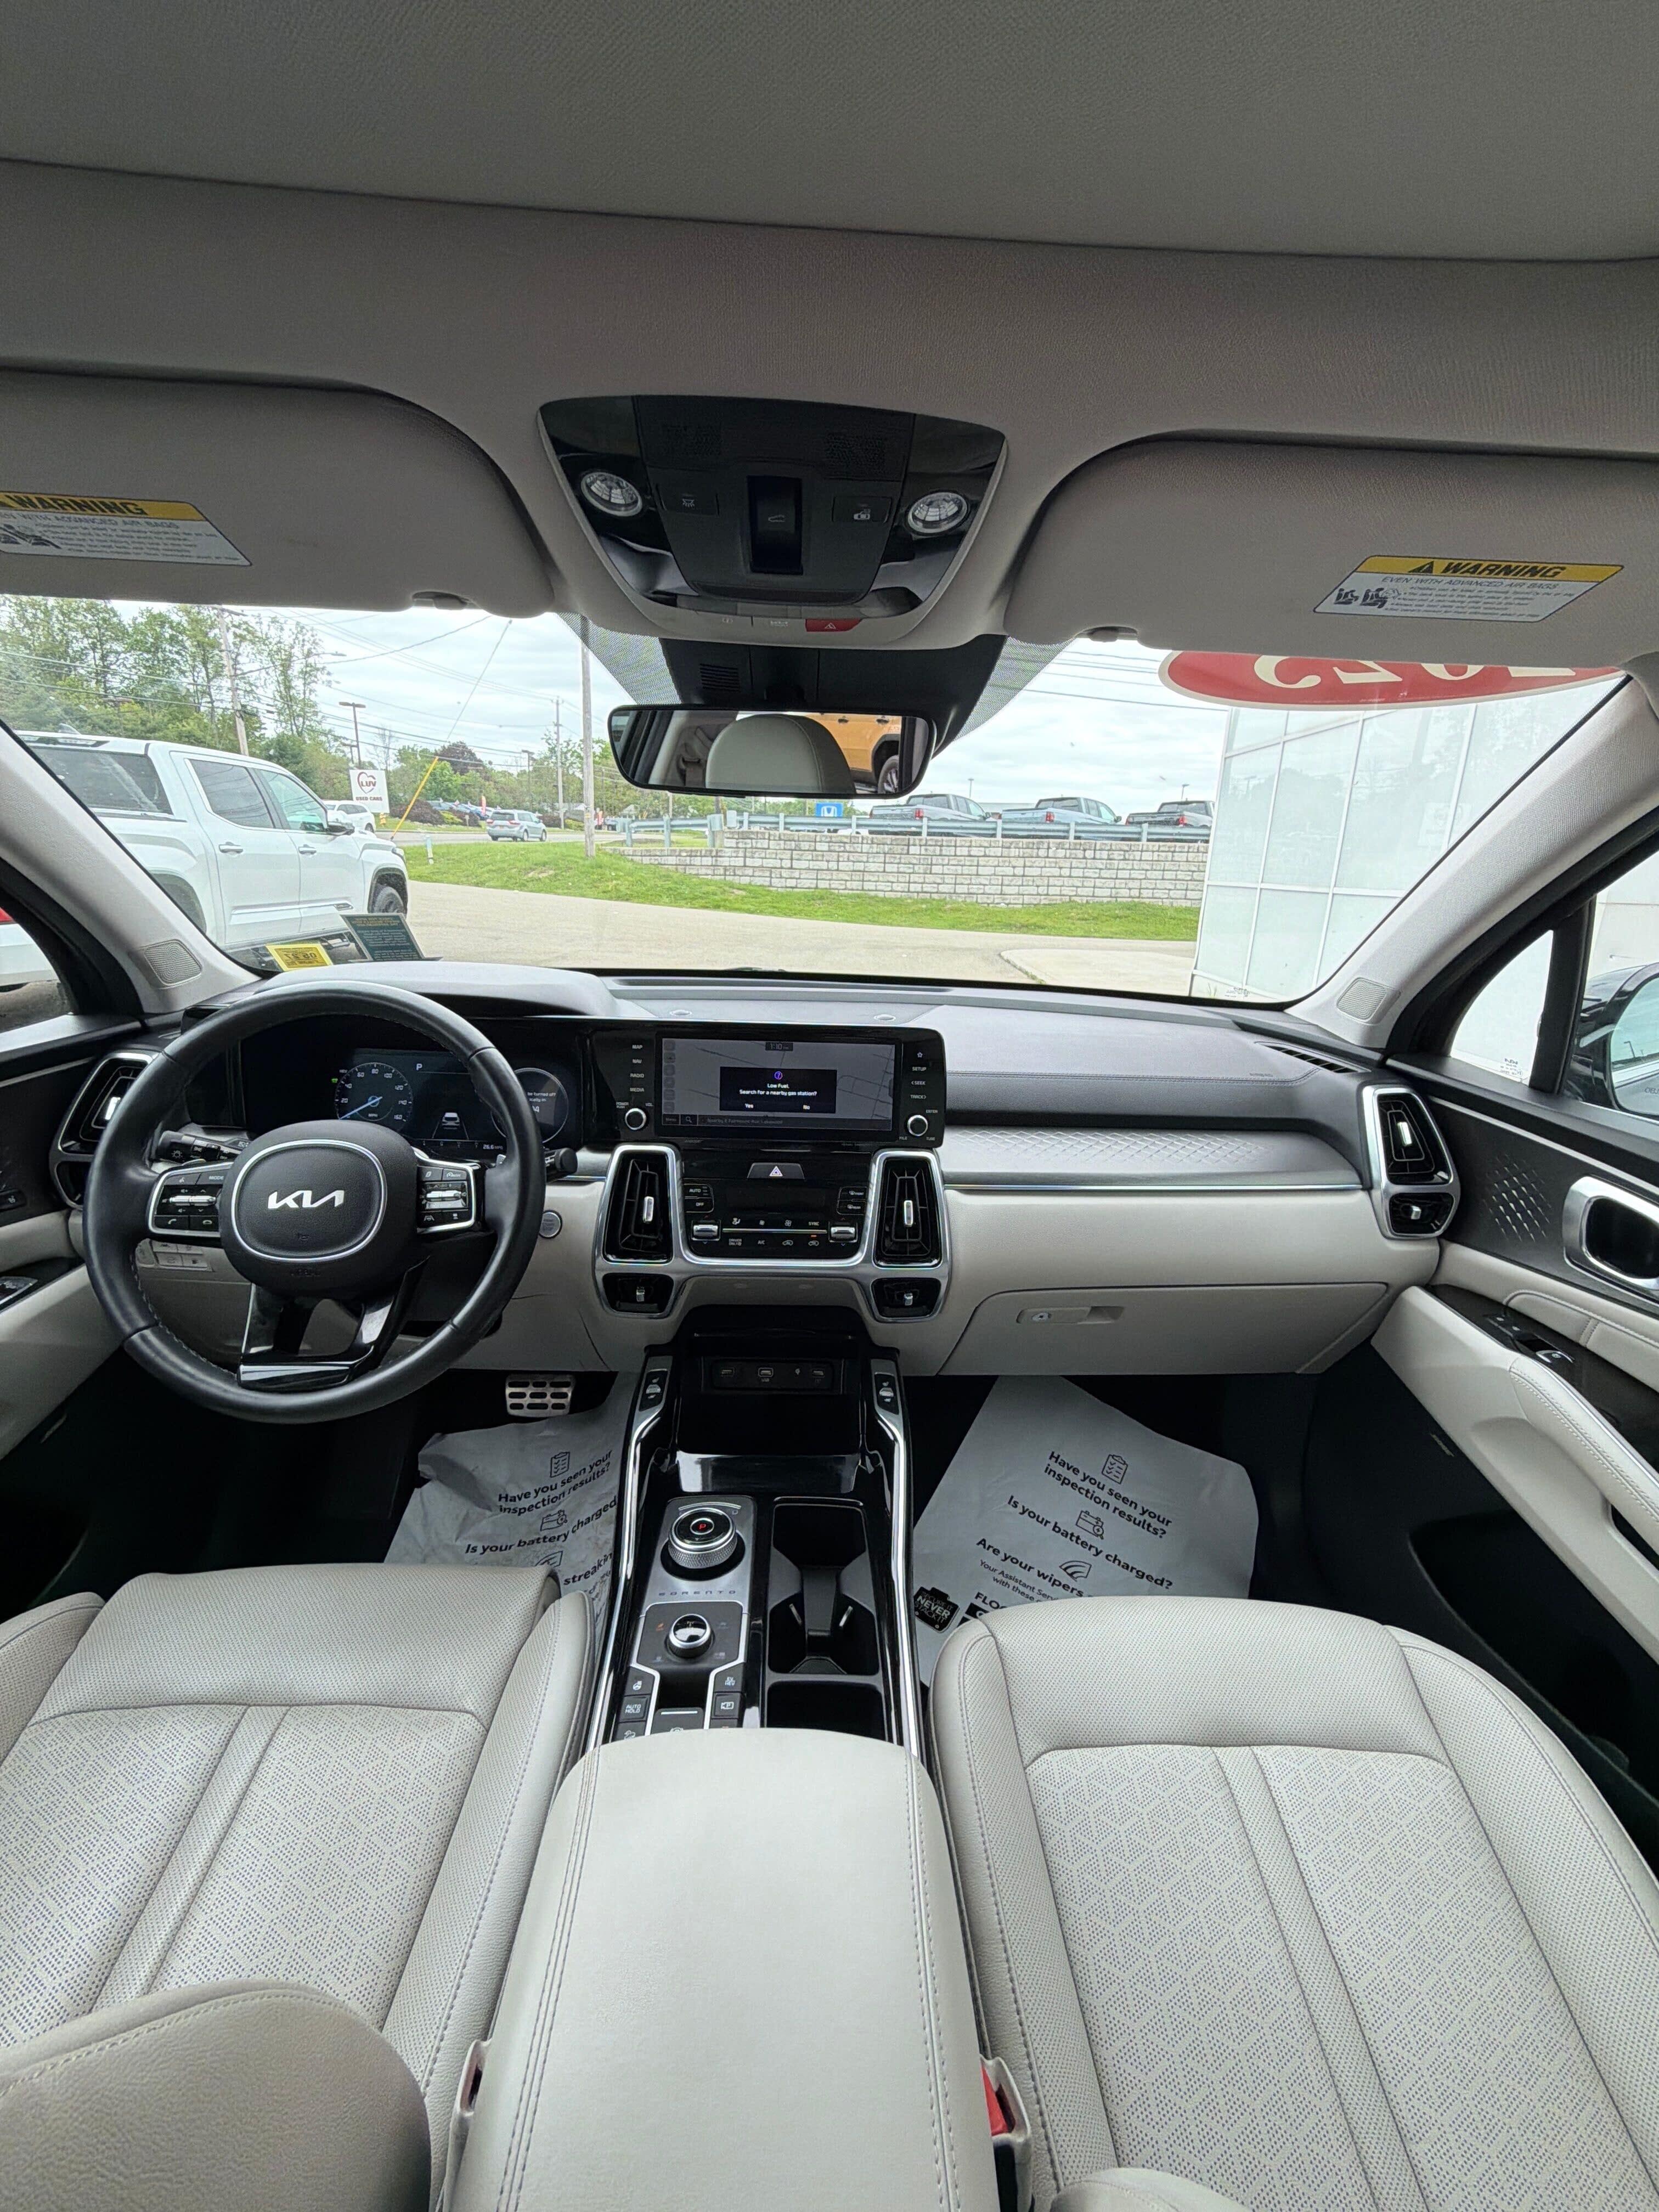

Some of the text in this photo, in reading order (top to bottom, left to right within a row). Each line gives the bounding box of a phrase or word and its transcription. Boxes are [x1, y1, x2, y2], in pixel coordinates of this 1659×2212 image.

[4, 494, 148, 515] WARNING
[1441, 561, 1566, 578] WARNING
[1445, 579, 1504, 587] ADVANCED
[268, 1190, 345, 1209] KIA
[498, 1449, 613, 1503] Have you seen your
[499, 1462, 611, 1516] inspection results?
[1048, 1450, 1172, 1527] Have you seen your
[1044, 1463, 1167, 1538] inspection results?
[465, 1543, 477, 1554] Is
[479, 1542, 516, 1555] your
[517, 1531, 569, 1549] battery
[1007, 1495, 1173, 1590] Is your battery charged?
[563, 1552, 613, 1585] streakin
[976, 1538, 1085, 1598] Are your wipers
[980, 1559, 998, 1573] Your
[998, 1570, 1036, 1592] Assistant
[992, 1576, 1035, 1601] with these
[916, 1595, 951, 1619] NEVER
